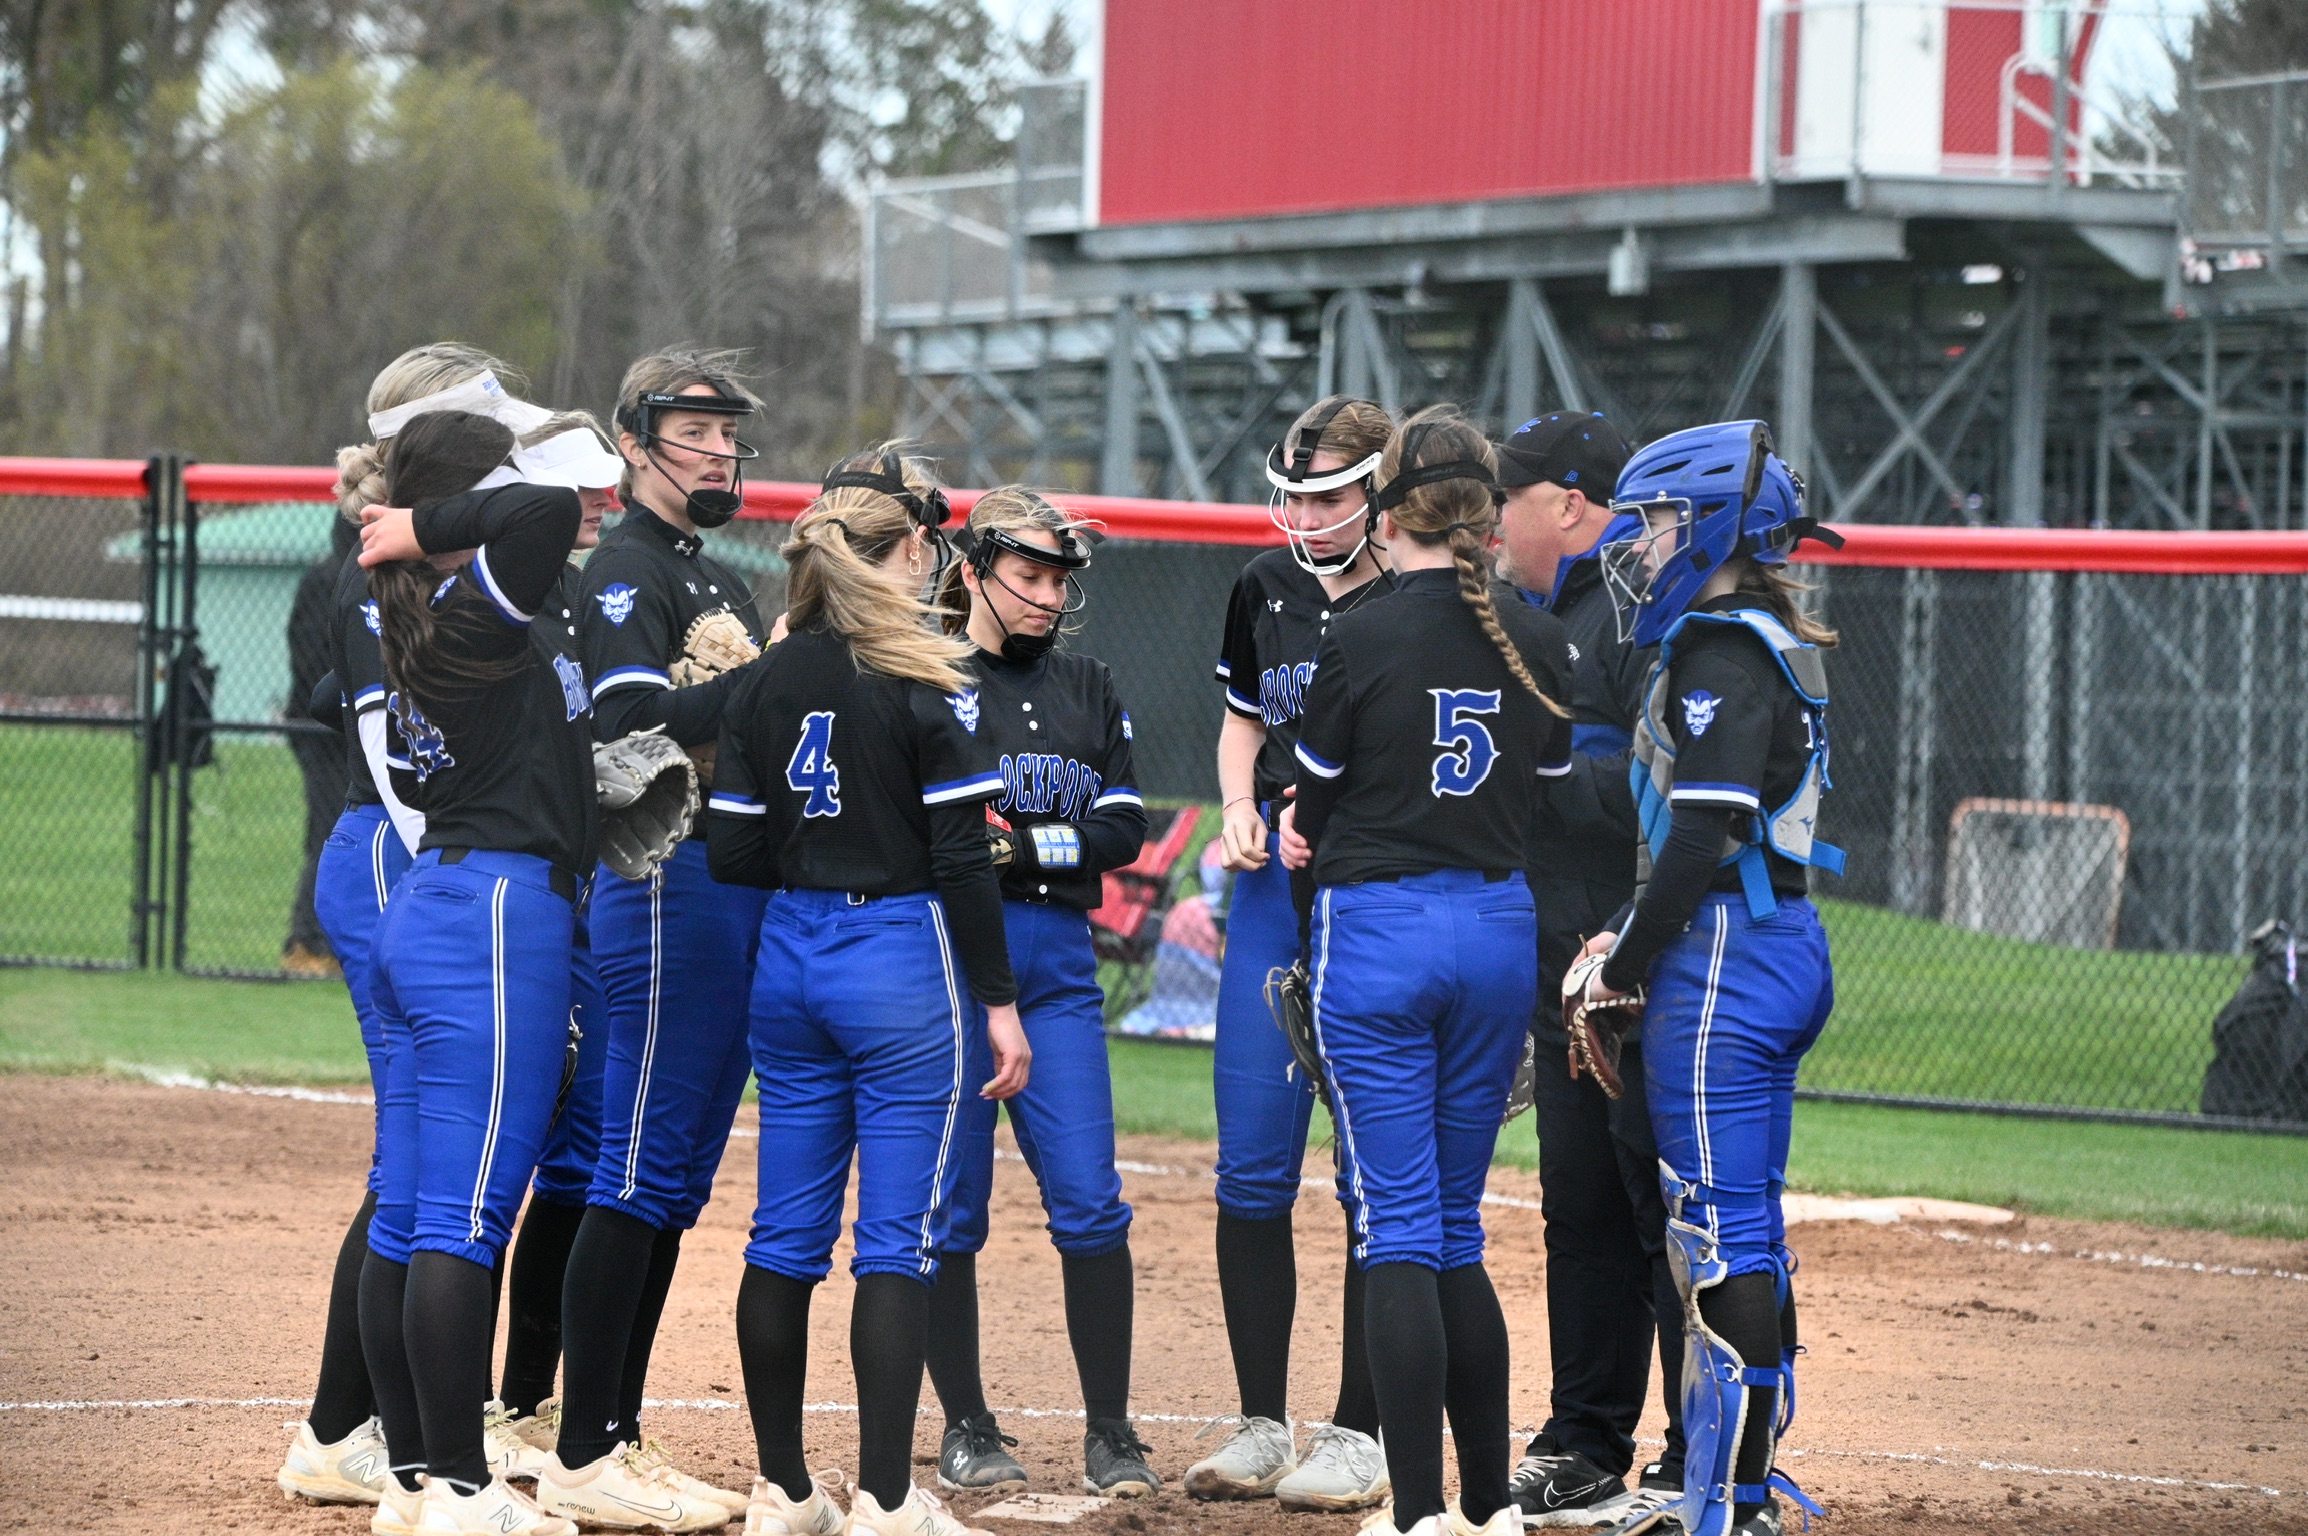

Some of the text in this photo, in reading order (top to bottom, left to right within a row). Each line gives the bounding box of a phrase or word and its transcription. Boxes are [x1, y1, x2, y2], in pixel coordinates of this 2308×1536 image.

[785, 711, 842, 819] 4
[1426, 688, 1502, 799] 5
[566, 1501, 596, 1515] renew
